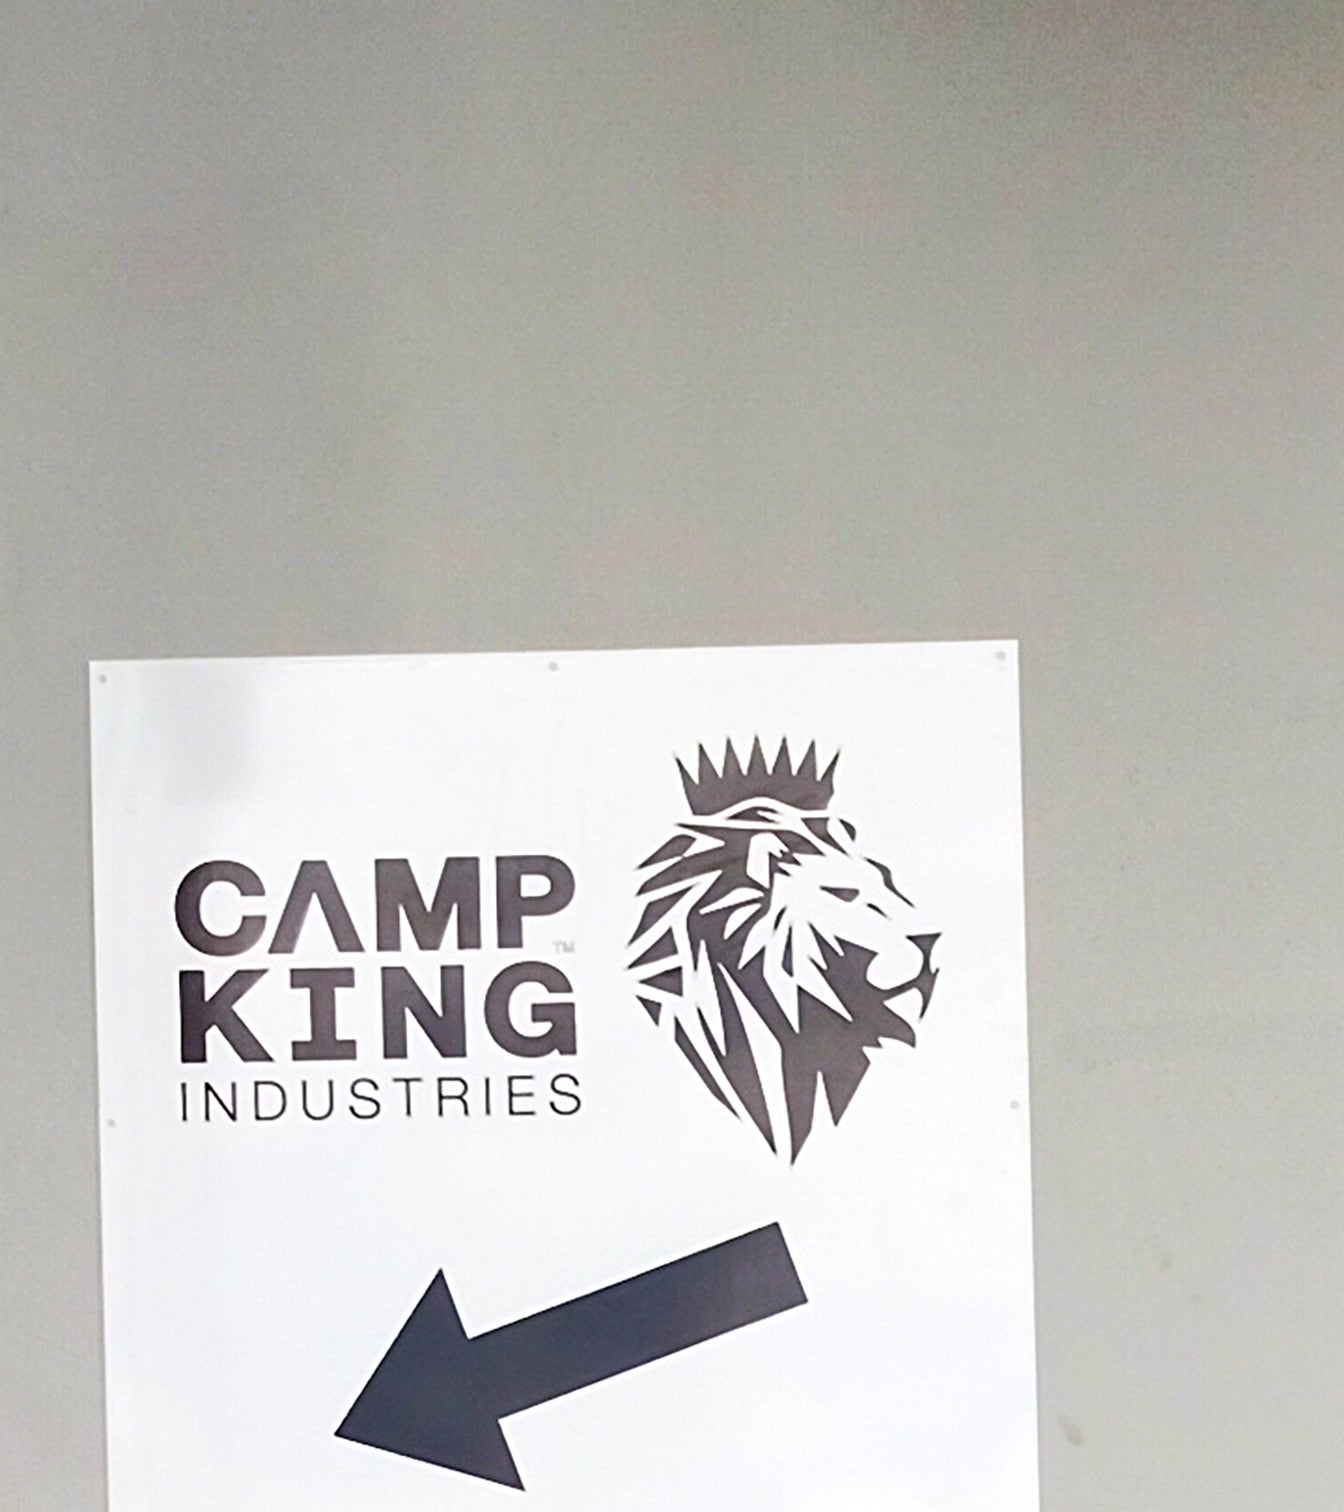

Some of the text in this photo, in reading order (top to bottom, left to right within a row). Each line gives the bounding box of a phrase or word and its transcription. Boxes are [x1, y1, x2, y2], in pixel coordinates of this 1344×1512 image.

[174, 854, 577, 957] CAMP
[178, 960, 579, 1064] KING
[180, 1073, 583, 1122] INDUSTRIES
